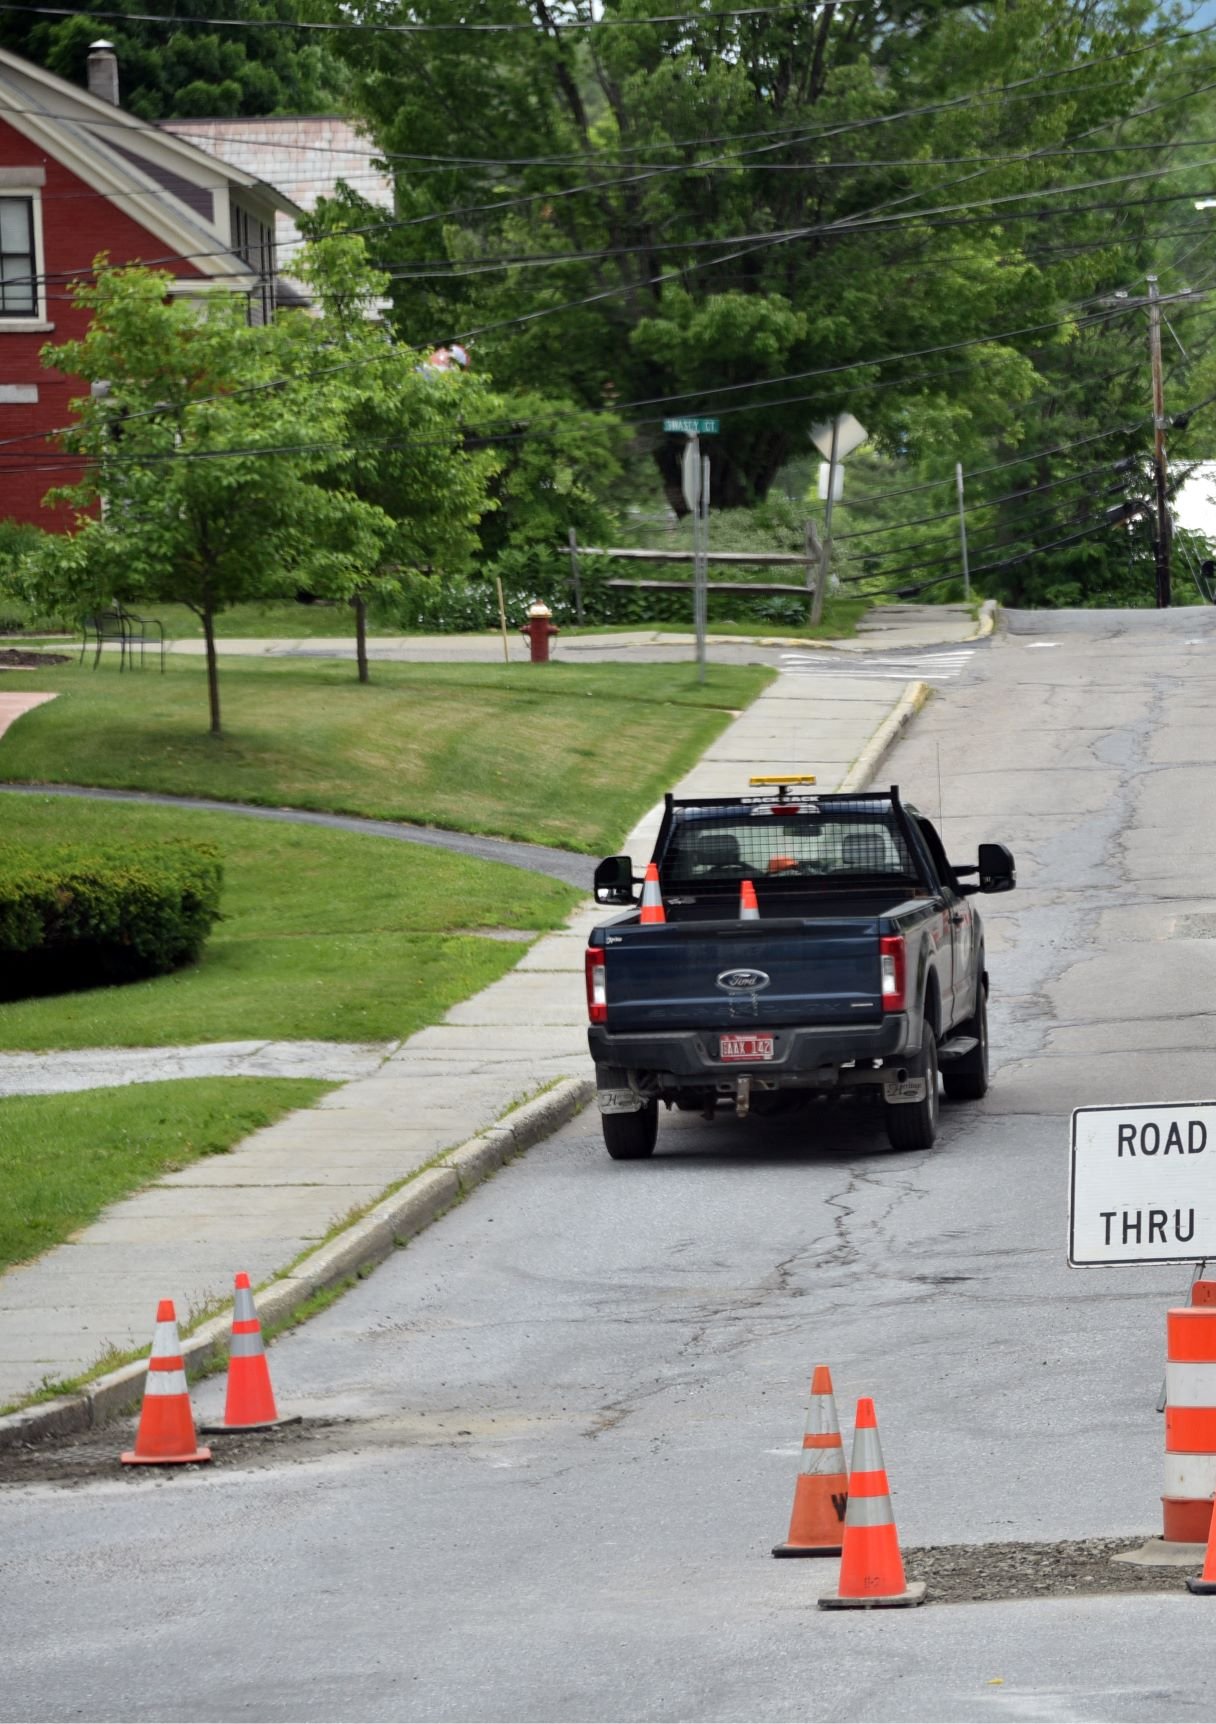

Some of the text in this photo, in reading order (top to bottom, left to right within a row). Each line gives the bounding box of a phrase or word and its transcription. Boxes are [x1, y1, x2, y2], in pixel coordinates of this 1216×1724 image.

[729, 974, 758, 987] Ford
[752, 1041, 771, 1054] 142
[1117, 1121, 1208, 1157] ROAD
[1100, 1208, 1195, 1246] THRU
